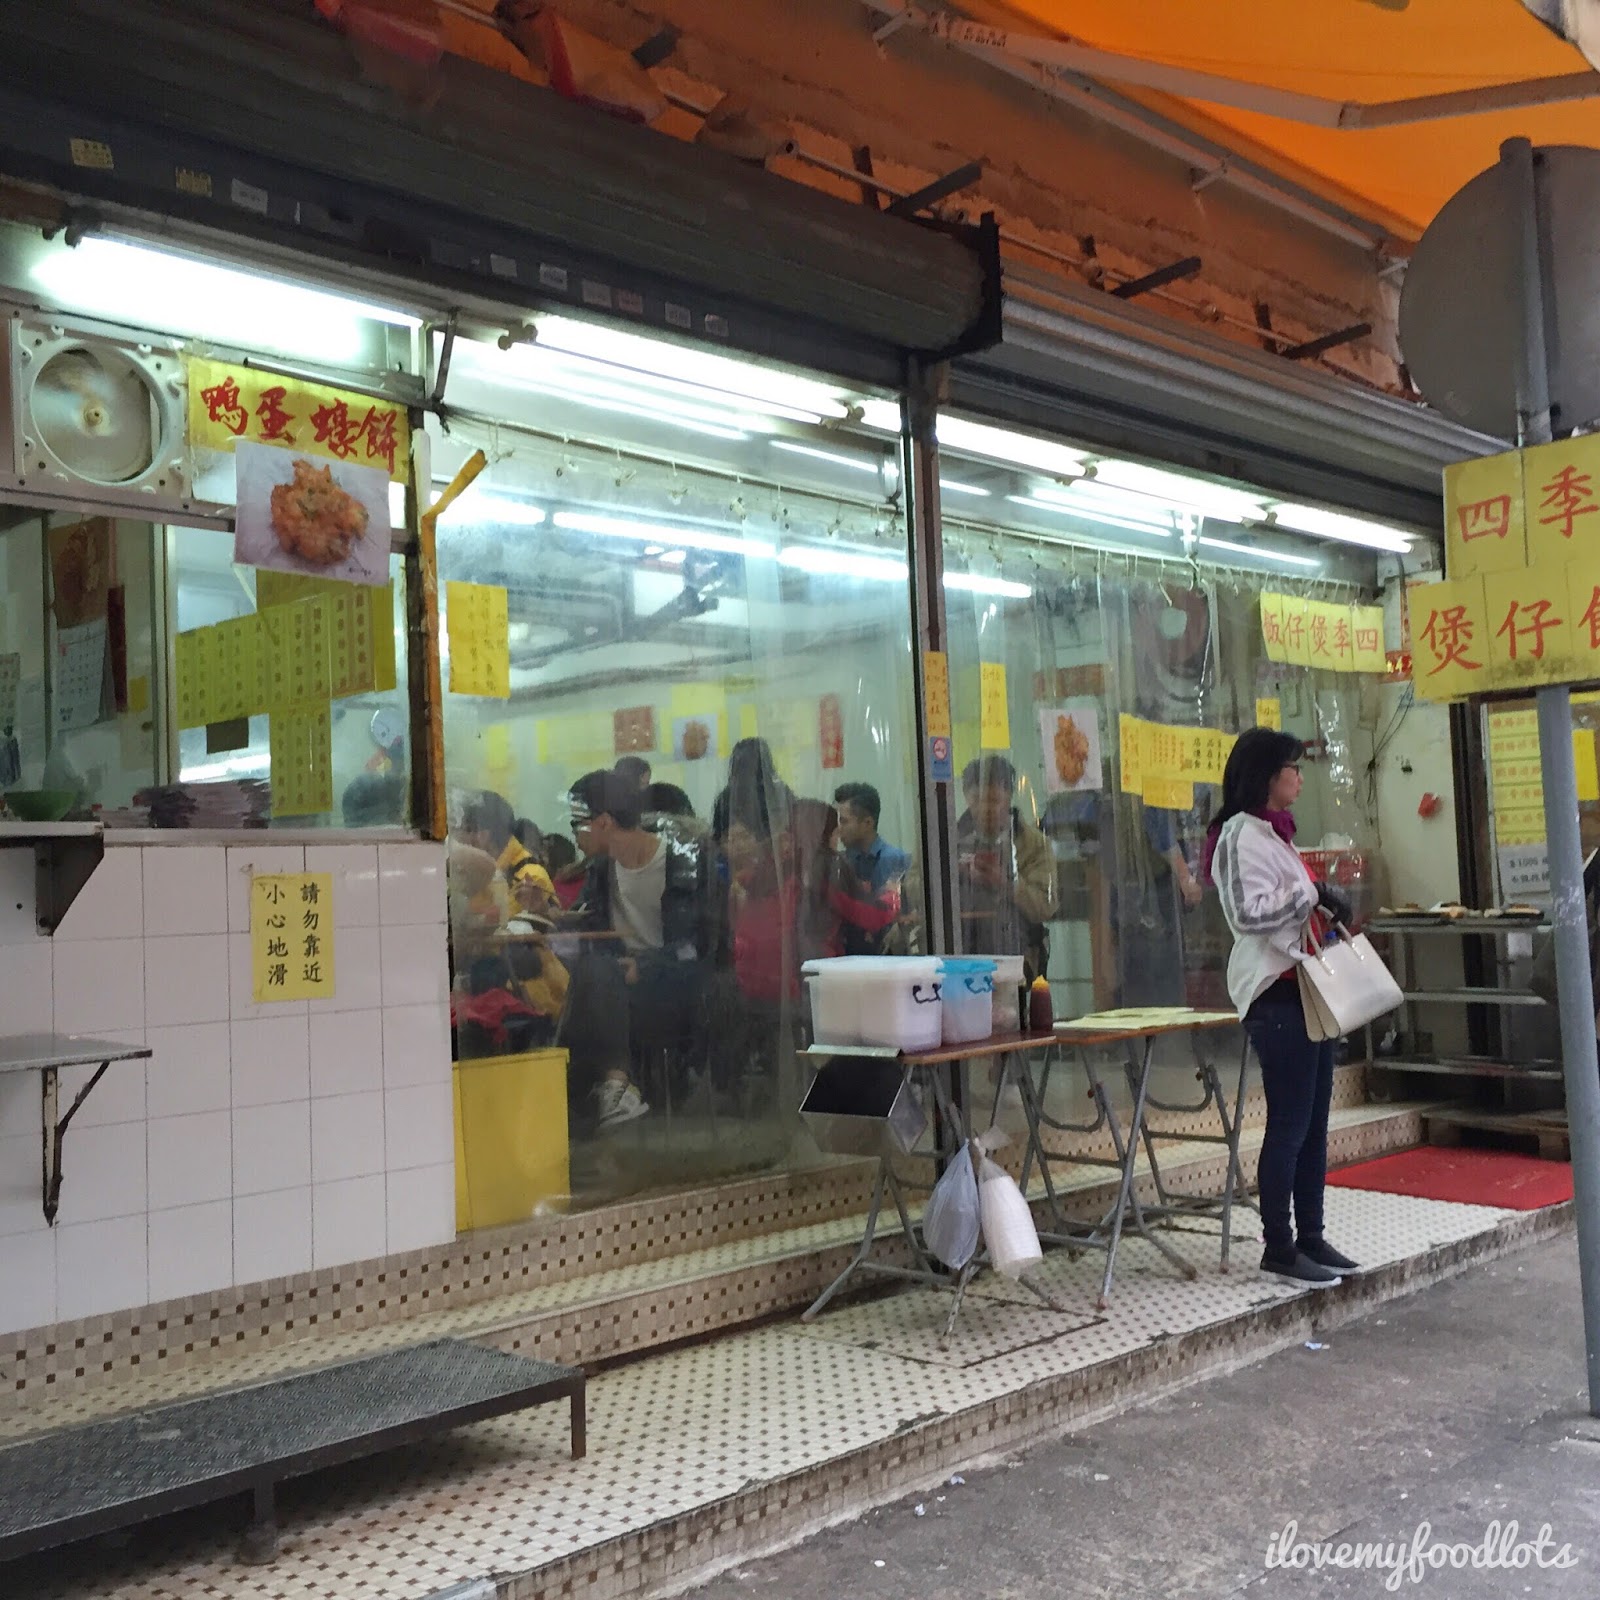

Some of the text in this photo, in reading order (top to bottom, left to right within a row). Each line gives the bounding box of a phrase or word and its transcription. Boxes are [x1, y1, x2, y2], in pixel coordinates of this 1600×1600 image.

[200, 376, 398, 475] 鴨蛋蠔餅
[1457, 464, 1600, 543] 四季
[266, 883, 289, 986] 小心地滑
[300, 881, 323, 983] 請勿靠近
